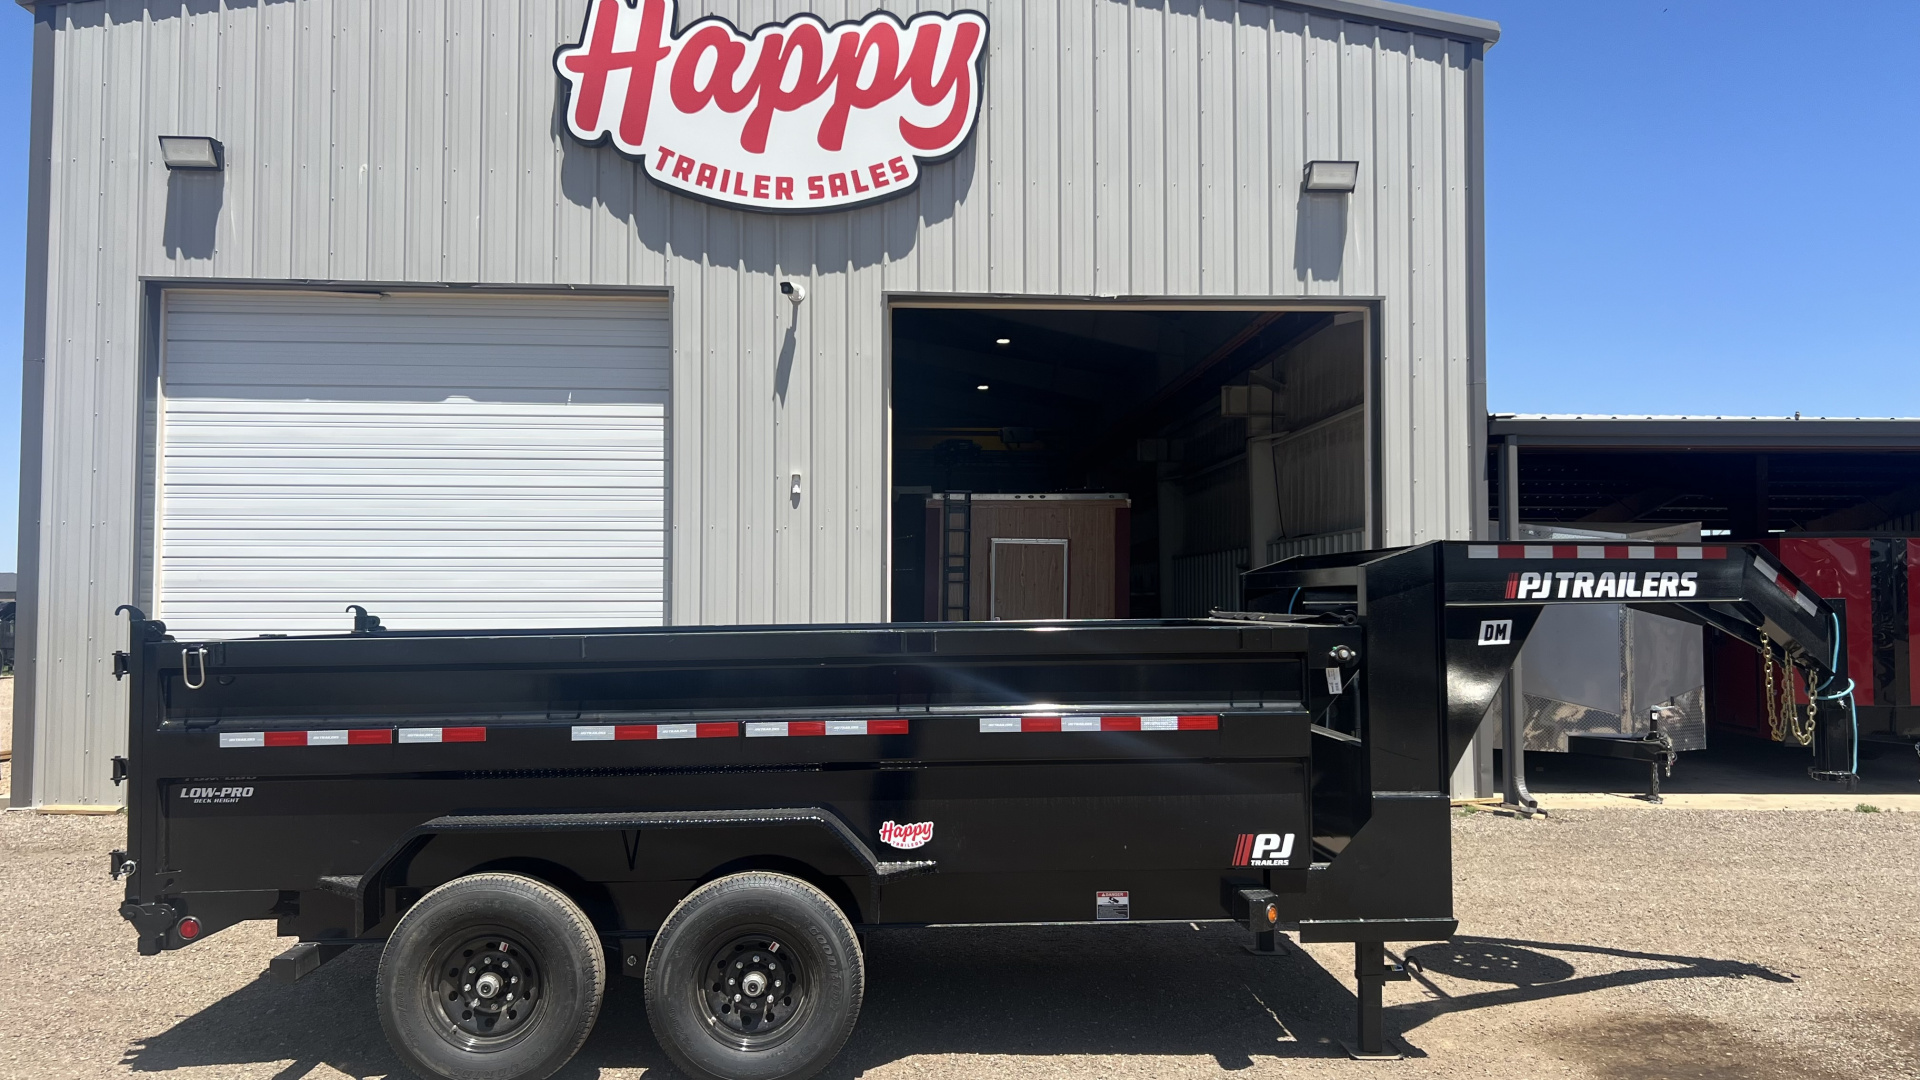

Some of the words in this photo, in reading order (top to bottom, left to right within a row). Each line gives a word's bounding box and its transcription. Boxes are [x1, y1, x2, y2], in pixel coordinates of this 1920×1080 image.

[564, 0, 981, 154] Happy
[655, 145, 794, 201] TRAILER
[808, 155, 910, 200] SALES
[1517, 572, 1552, 599] PJ
[1555, 572, 1698, 599] TRAILERS
[1484, 623, 1508, 642] DM
[180, 786, 255, 798] LOW-PRO
[880, 822, 932, 842] Happy
[1251, 833, 1296, 859] PJ
